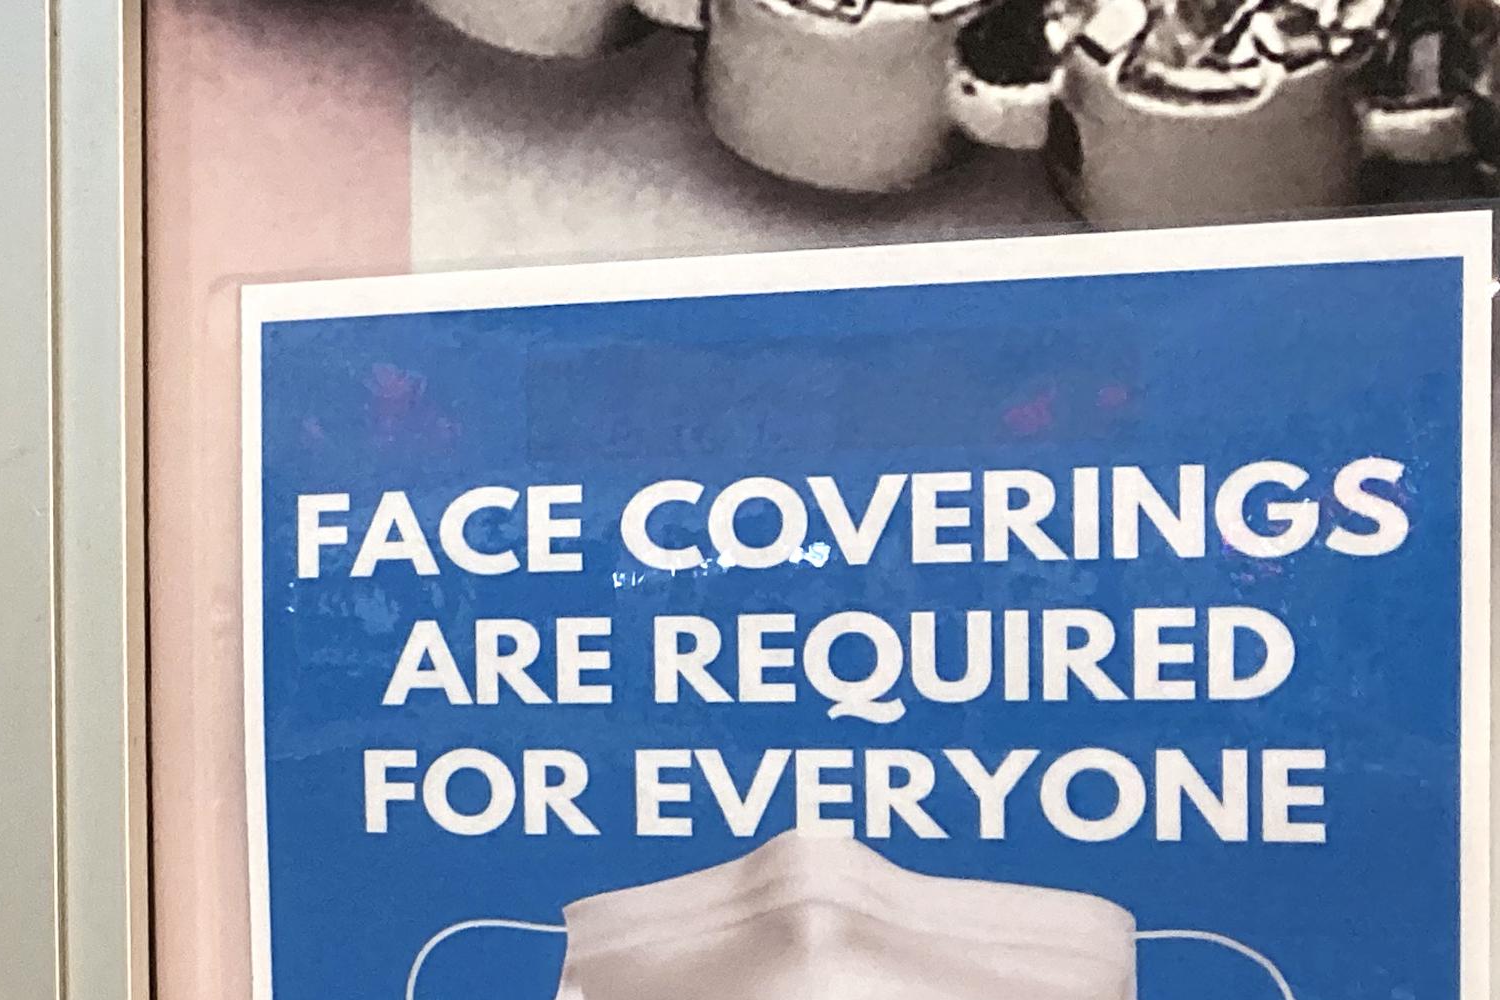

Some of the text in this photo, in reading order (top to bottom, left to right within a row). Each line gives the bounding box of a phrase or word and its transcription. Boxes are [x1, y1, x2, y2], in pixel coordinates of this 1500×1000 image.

[297, 456, 1410, 579] FACE COVERINGS
[382, 606, 1296, 724] ARE REQUIRED
[363, 747, 1326, 843] FOR EVERYONE
